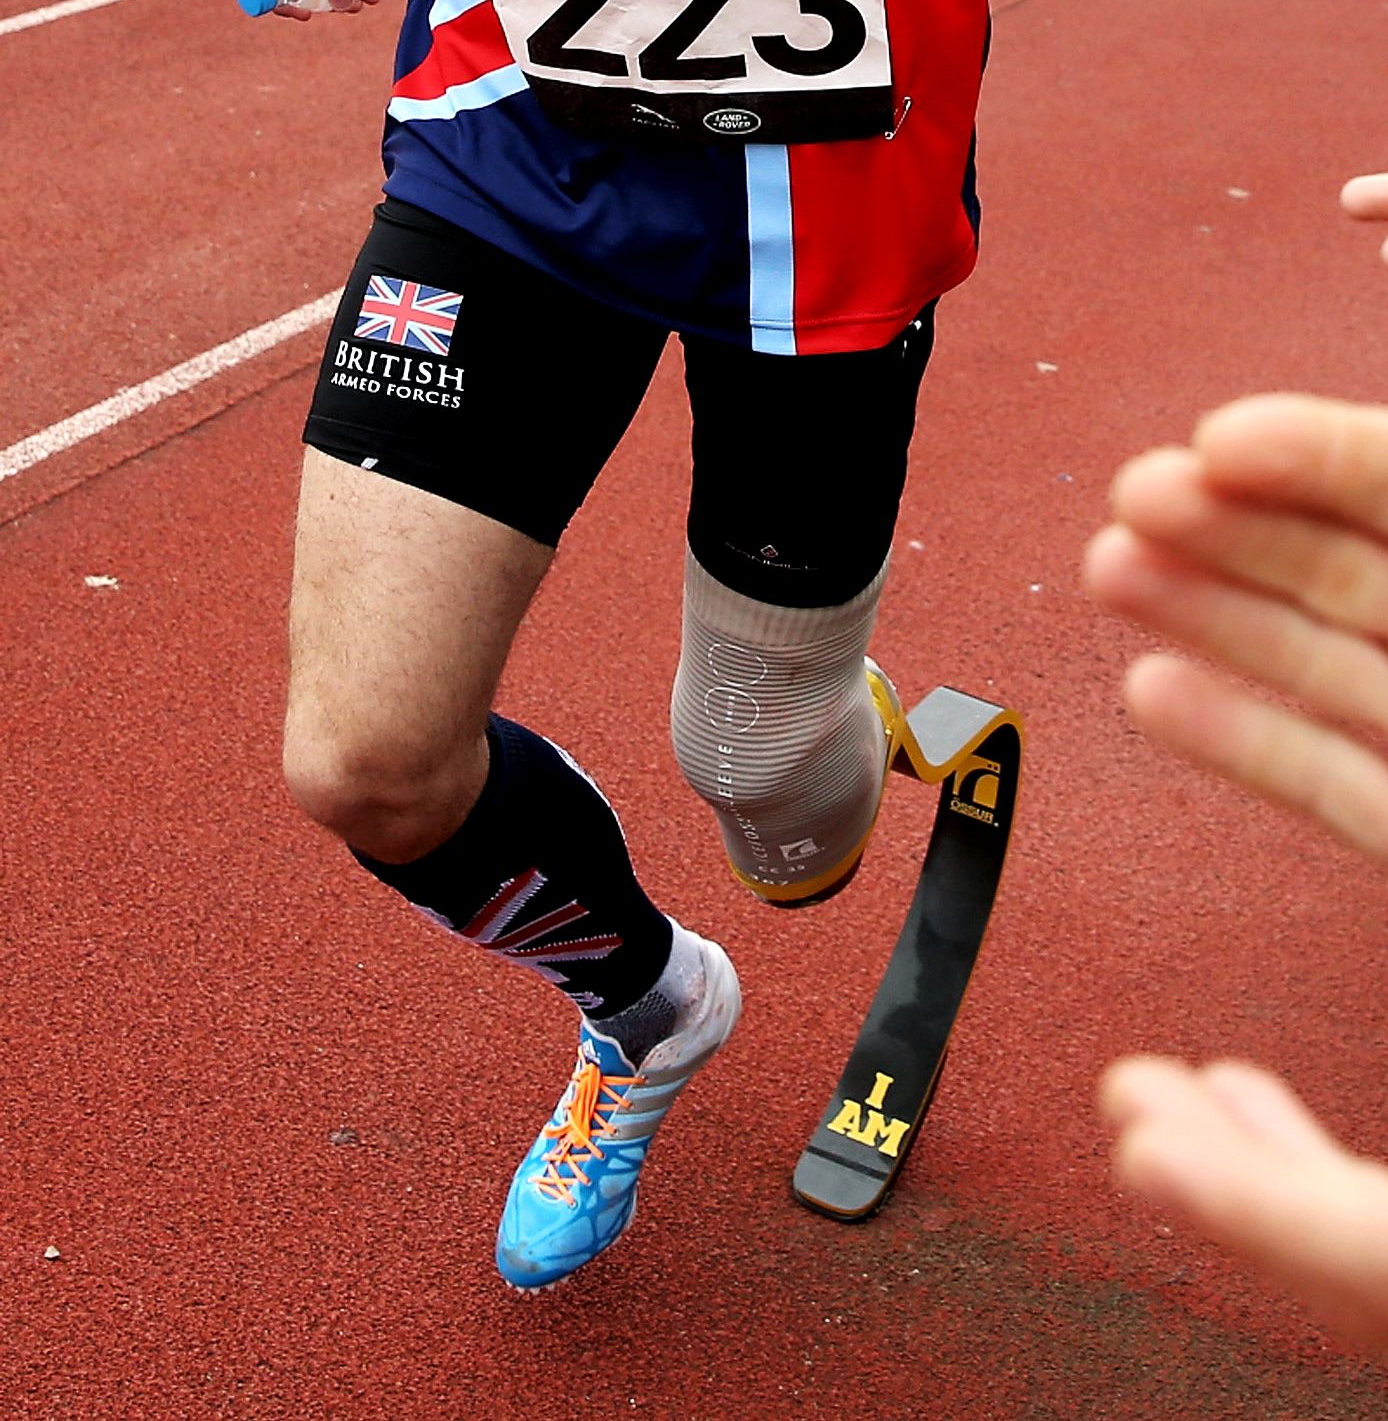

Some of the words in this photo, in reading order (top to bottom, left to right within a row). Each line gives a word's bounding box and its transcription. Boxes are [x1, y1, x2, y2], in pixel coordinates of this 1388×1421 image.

[334, 340, 465, 392] BRITISH
[331, 372, 381, 394] ARMED
[386, 383, 461, 409] FORCES
[865, 1071, 894, 1109] I
[827, 1099, 911, 1157] AM
